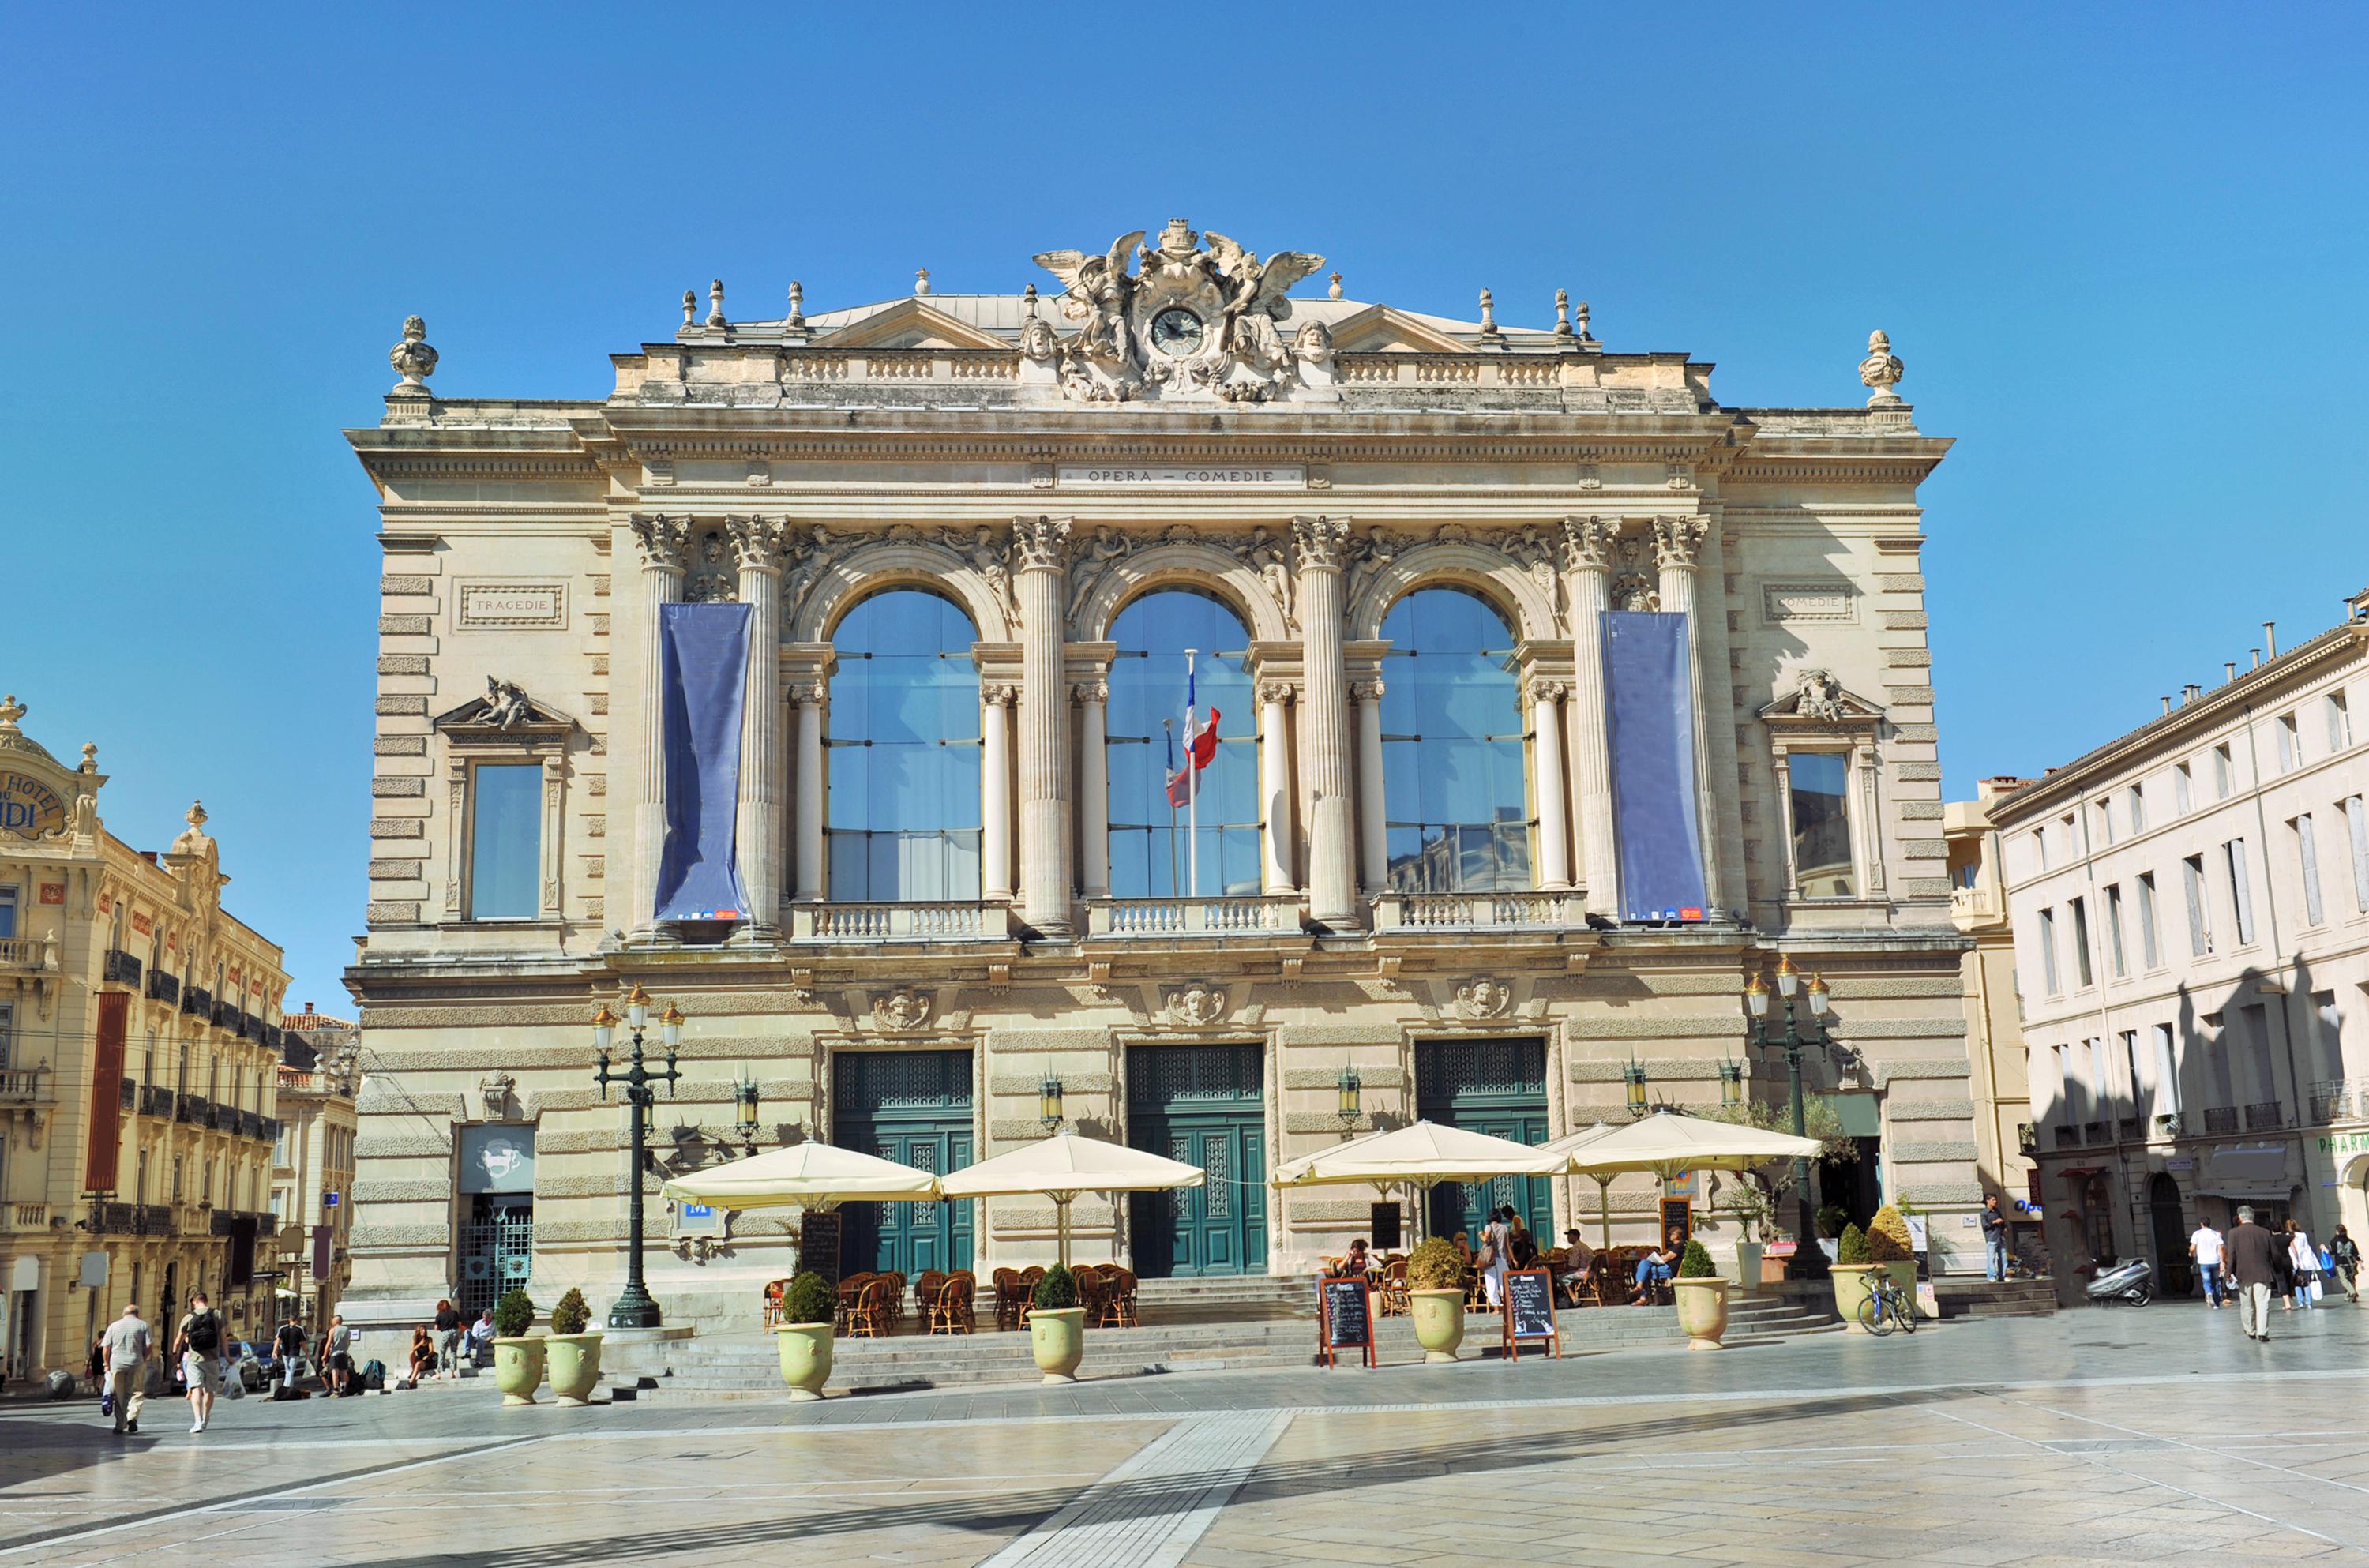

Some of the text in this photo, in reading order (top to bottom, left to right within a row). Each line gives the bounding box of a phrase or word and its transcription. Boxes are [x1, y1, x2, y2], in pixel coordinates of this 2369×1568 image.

[1089, 471, 1151, 482] OPERA
[1185, 471, 1275, 482] COMEDIE
[475, 601, 548, 610] TRAGEDIE
[1778, 598, 1839, 606] COMEDIE
[6, 775, 59, 817] HOTEL
